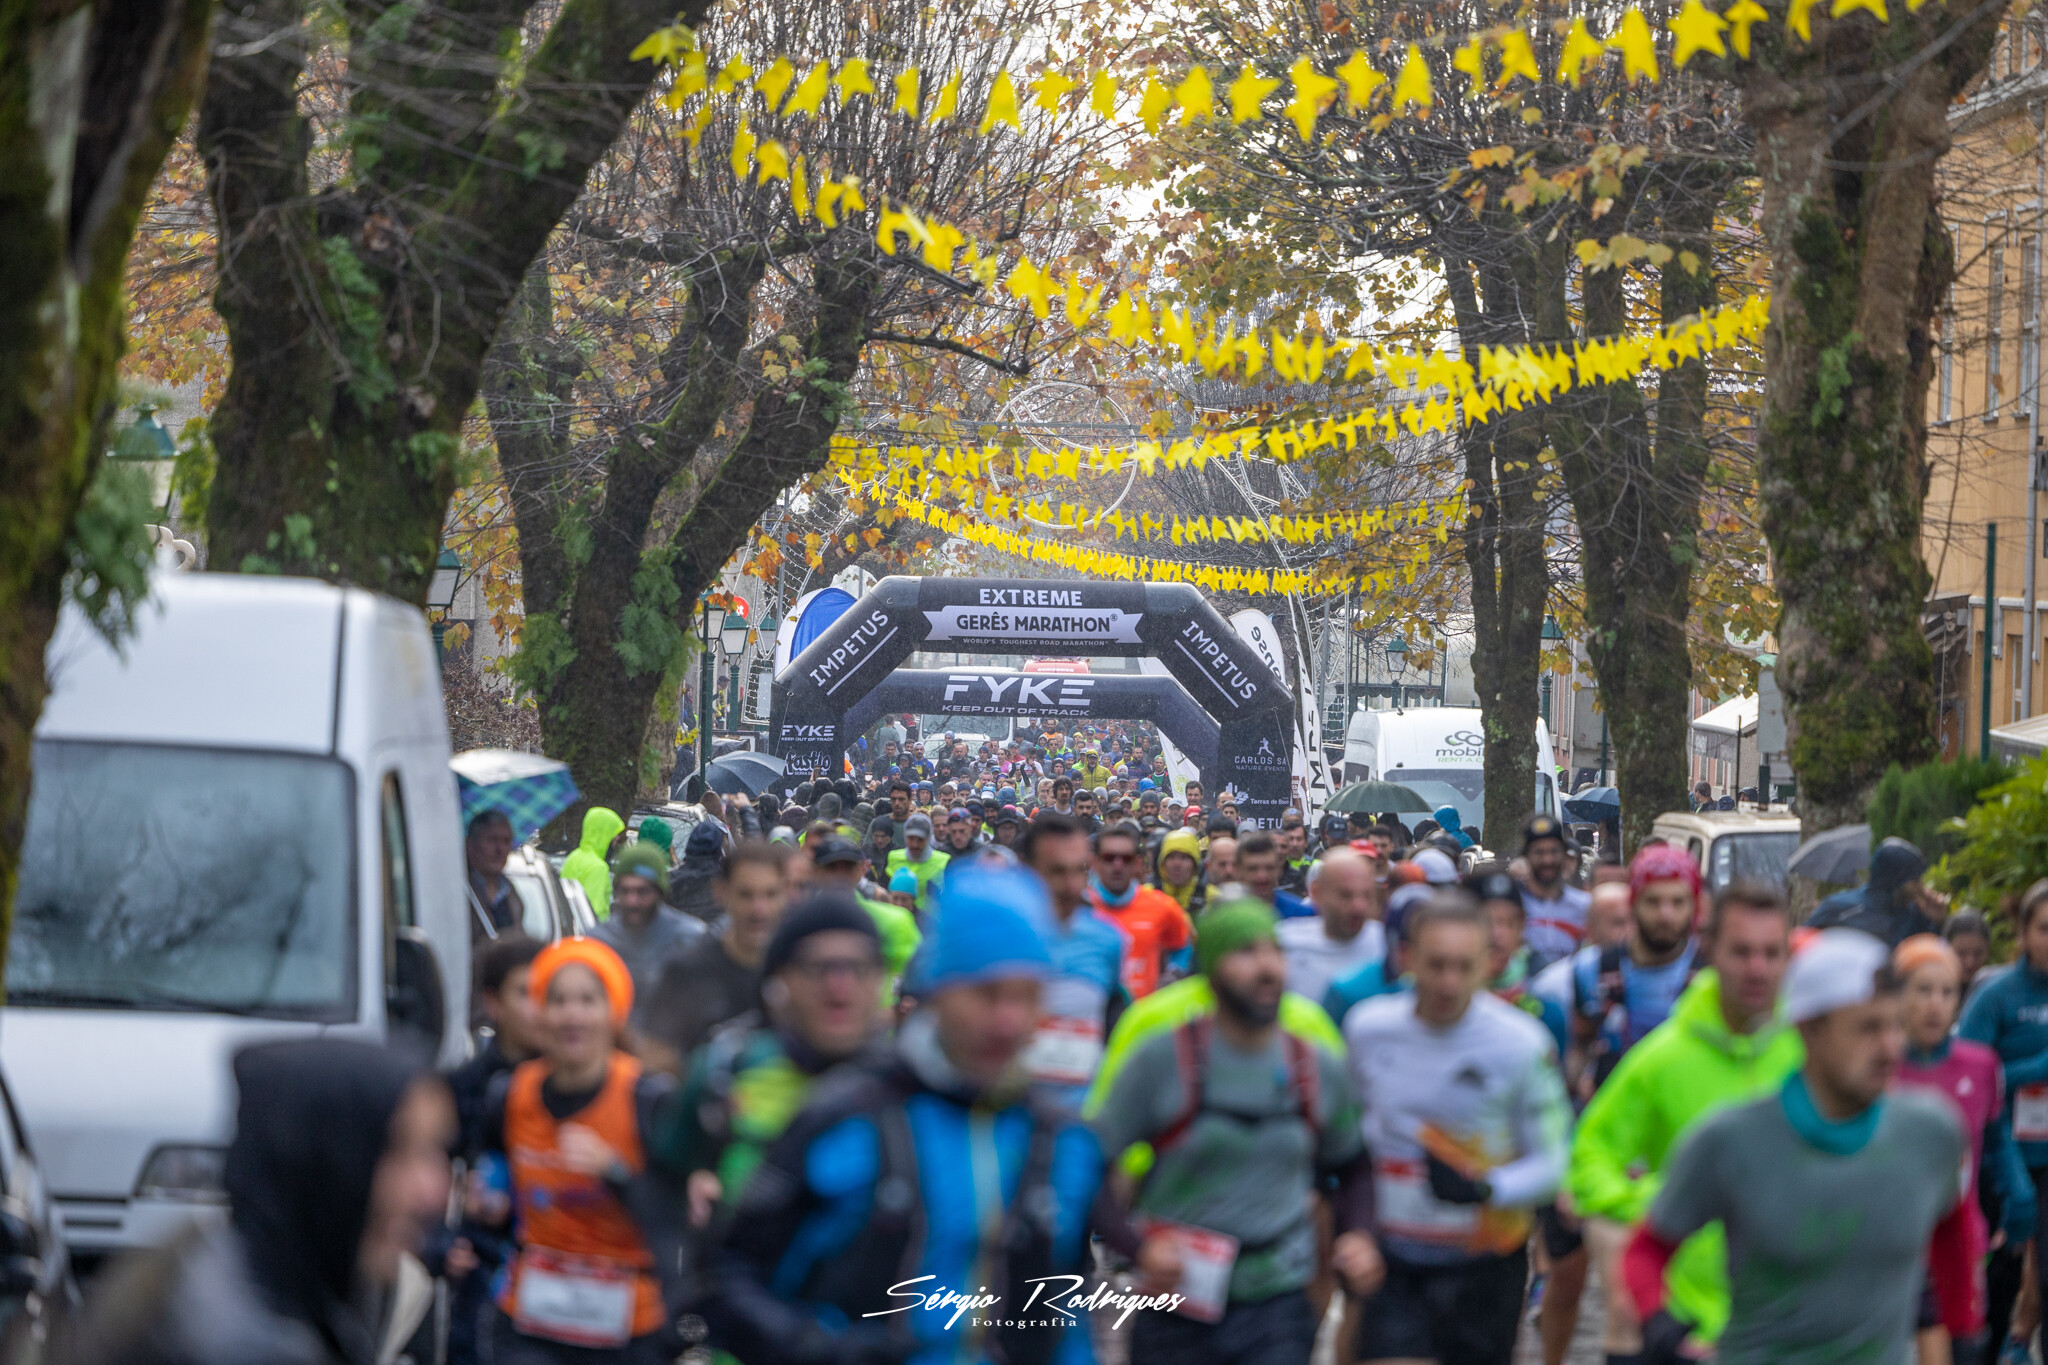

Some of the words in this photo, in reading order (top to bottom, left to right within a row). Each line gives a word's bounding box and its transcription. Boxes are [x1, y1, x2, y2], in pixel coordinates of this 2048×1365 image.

[979, 588, 1083, 607] EXTREME
[956, 611, 1009, 631] GERÊS
[809, 610, 889, 687] IMPETUS
[1182, 620, 1257, 700] IMPETUS
[943, 675, 1096, 706] FYKE
[941, 704, 981, 713] KEEP
[983, 706, 1015, 714] OUT
[1017, 707, 1038, 715] OF
[1039, 708, 1091, 716] TRACK
[781, 724, 836, 737] FYKE
[1234, 755, 1273, 765] CARLOS
